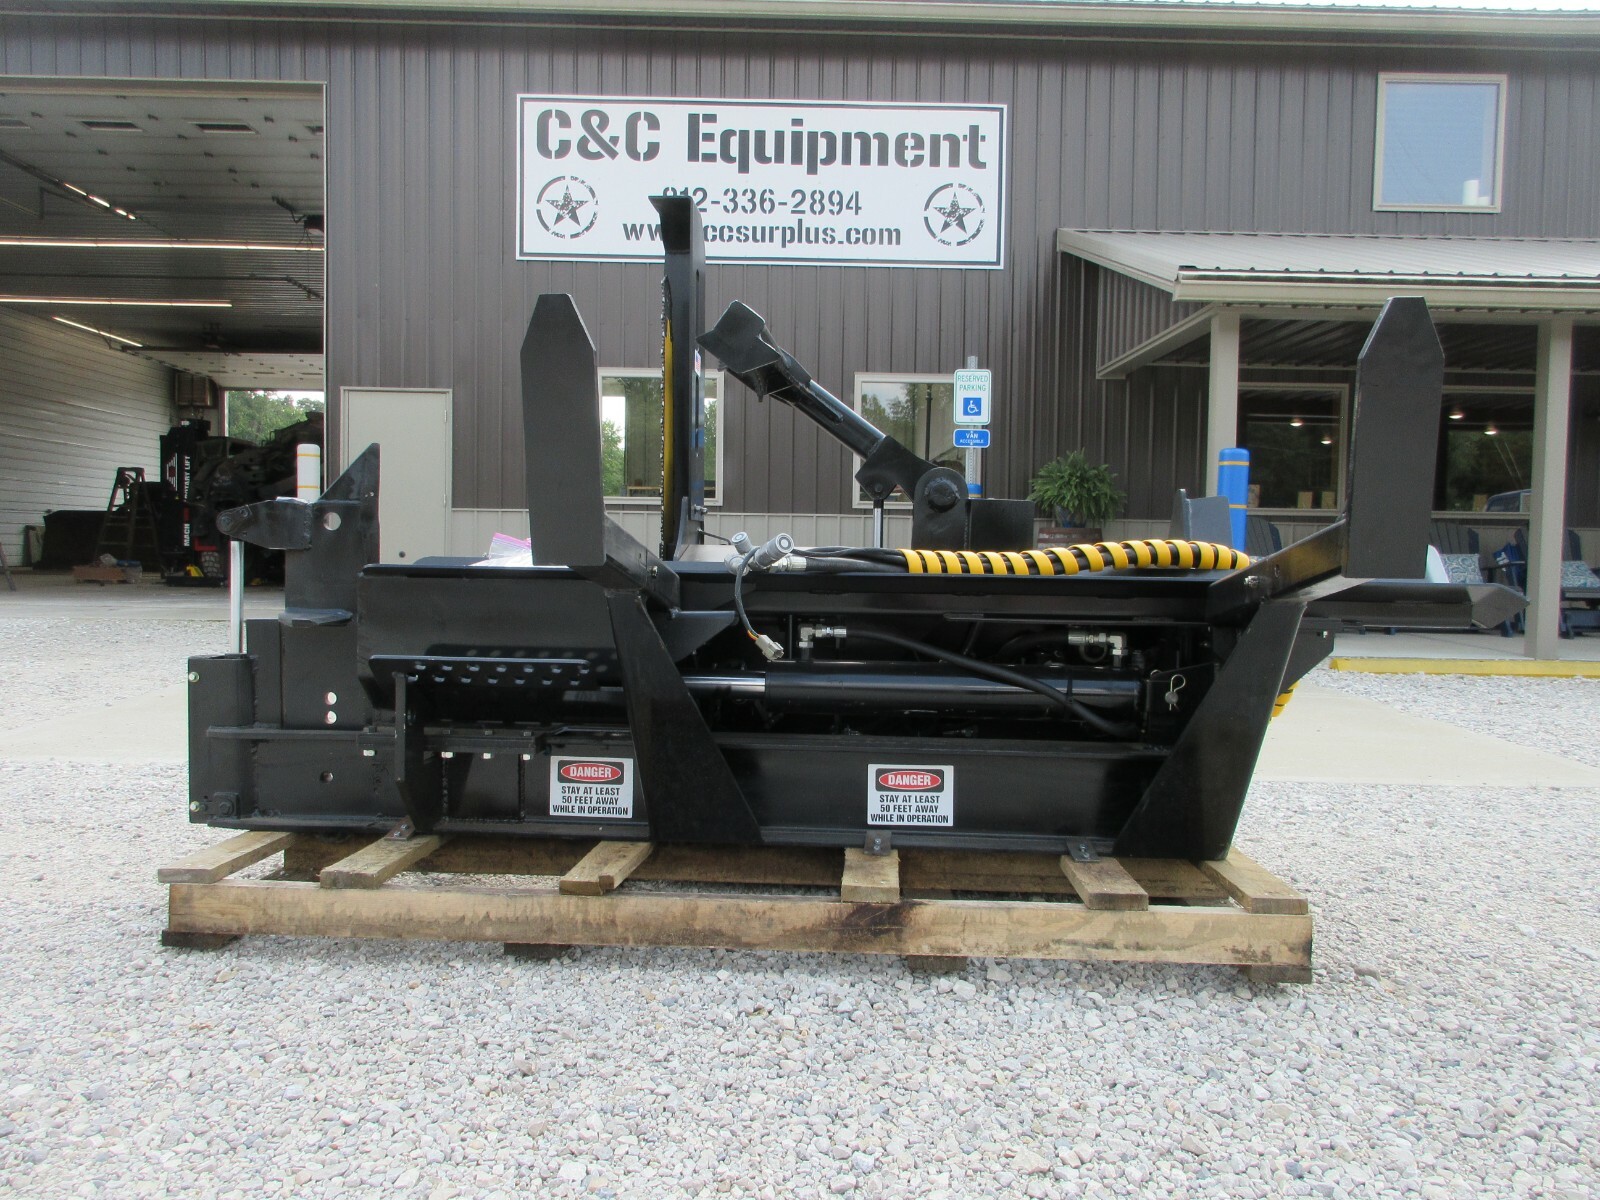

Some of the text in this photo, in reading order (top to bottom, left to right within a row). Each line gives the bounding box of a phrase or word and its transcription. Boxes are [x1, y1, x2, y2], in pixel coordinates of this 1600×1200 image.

[536, 109, 987, 175] C&C Equipment
[622, 218, 901, 248] wwccsurplus.com
[569, 766, 612, 778] DANGER
[888, 774, 931, 786] DANGER
[561, 786, 620, 796] STAY AT LEAST
[575, 796, 593, 804] FEET
[596, 797, 619, 805] AWAY
[879, 795, 940, 803] STAY AT LEAST
[552, 805, 628, 815] WHILE IN OPERATION
[880, 804, 890, 812] 50
[915, 805, 939, 813] AWAY
[871, 813, 949, 823] WHILE IN OPERATION
